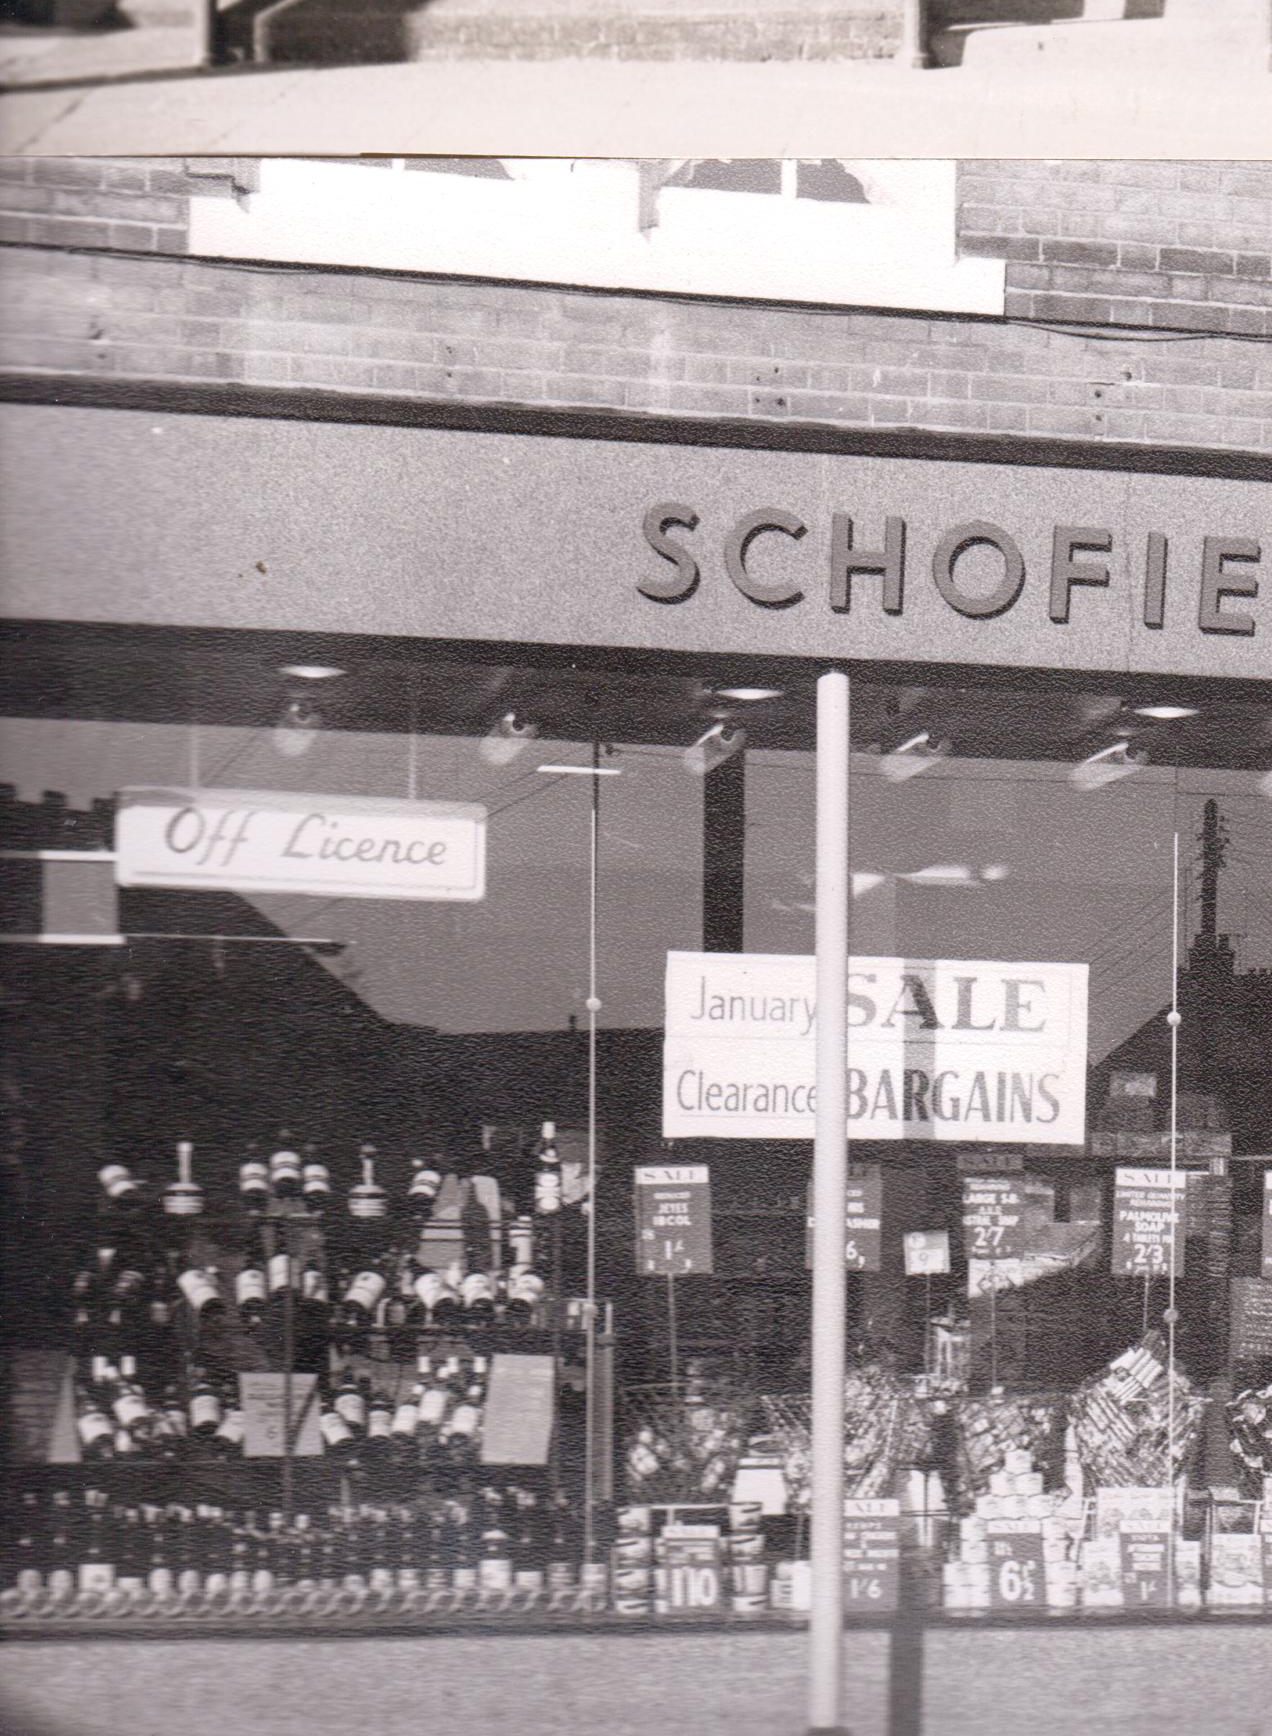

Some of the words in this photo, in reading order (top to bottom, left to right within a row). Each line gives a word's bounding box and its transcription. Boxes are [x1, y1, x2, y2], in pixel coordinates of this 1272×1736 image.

[164, 806, 257, 867] Off
[280, 812, 448, 866] Licence
[690, 974, 817, 1037] January
[846, 972, 1048, 1033] SALE
[675, 1068, 817, 1114] Clearance
[845, 1067, 1061, 1124] BARGAINS
[1134, 1221, 1165, 1233] SOAP
